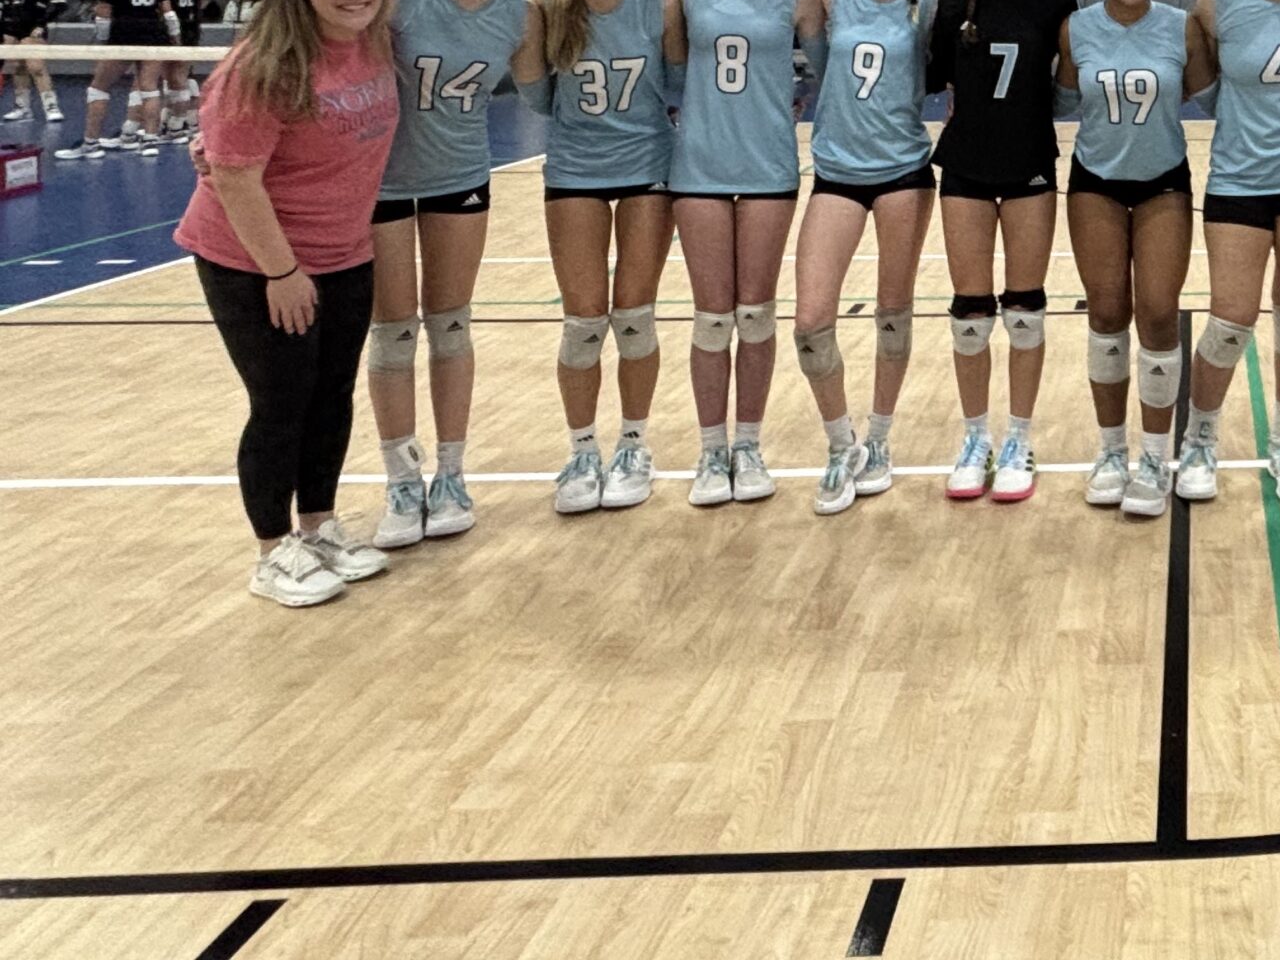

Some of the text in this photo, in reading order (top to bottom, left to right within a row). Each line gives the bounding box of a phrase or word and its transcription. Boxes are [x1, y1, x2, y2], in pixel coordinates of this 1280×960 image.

[414, 55, 490, 113] 14
[571, 55, 648, 116] 37
[714, 33, 750, 94] 8
[851, 41, 886, 101] 9
[989, 42, 1019, 100] 7
[1096, 68, 1160, 125] 19
